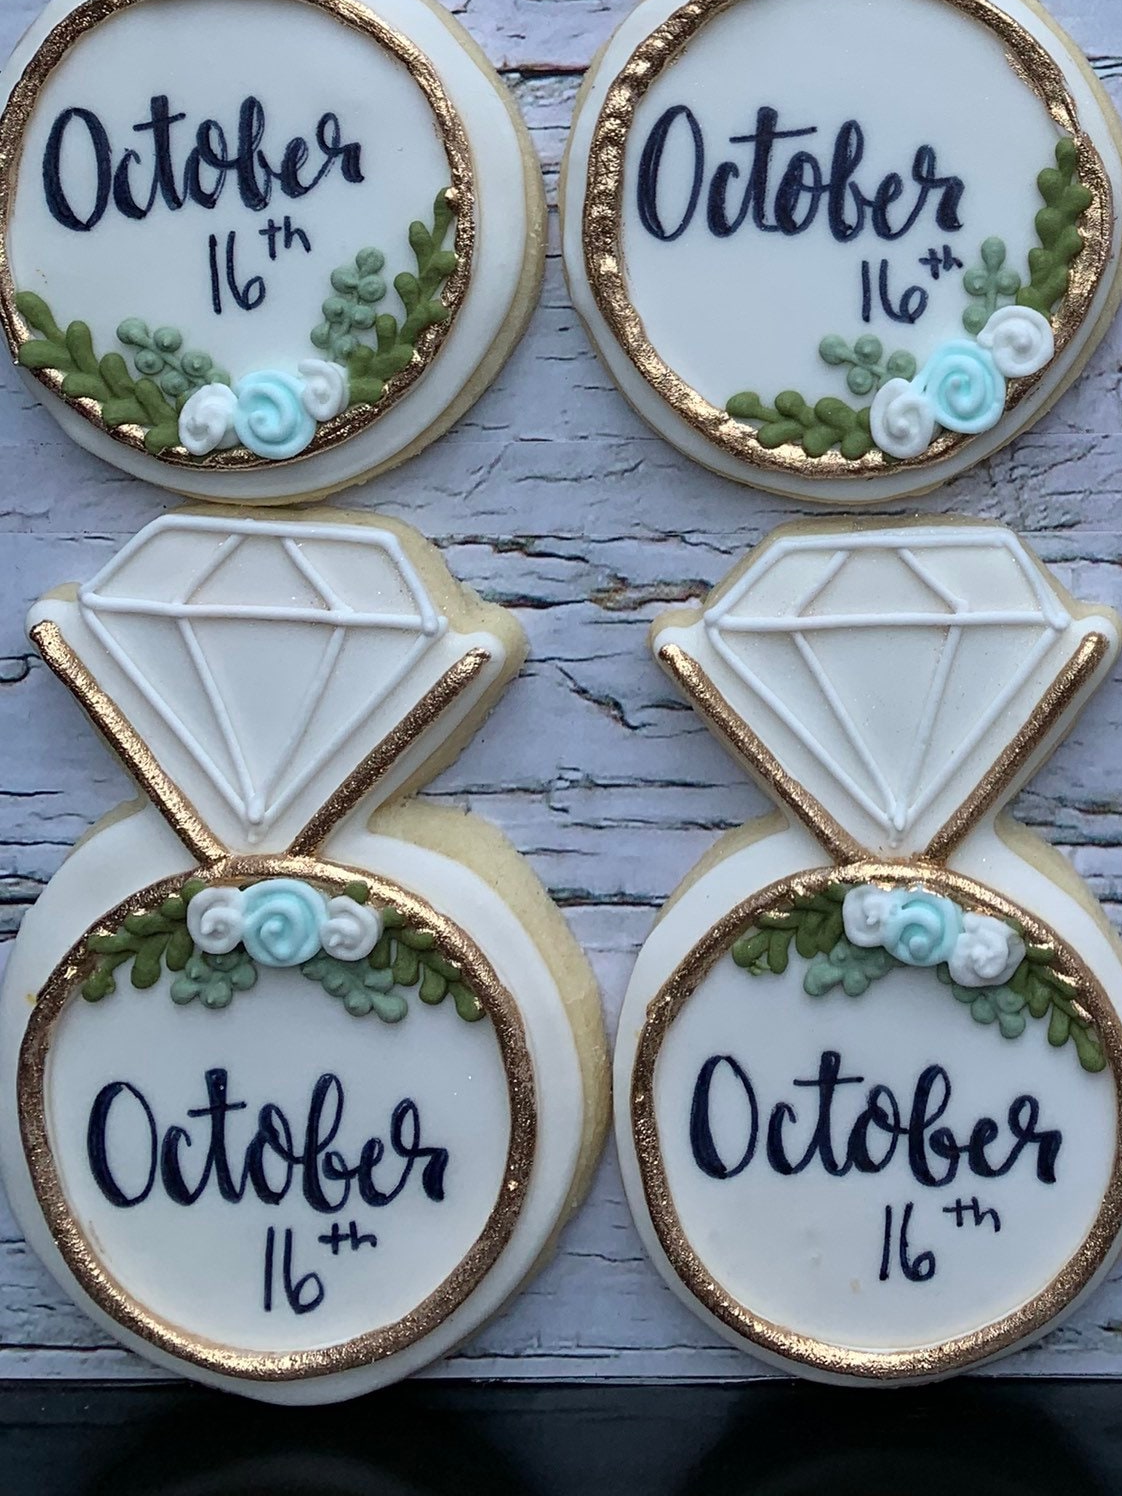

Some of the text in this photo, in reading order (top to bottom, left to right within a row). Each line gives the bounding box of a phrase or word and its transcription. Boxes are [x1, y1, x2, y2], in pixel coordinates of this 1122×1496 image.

[41, 94, 366, 233] October
[636, 104, 966, 244] October
[208, 215, 312, 316] 16th
[861, 244, 964, 325] 16th
[86, 1067, 450, 1215] October
[689, 1050, 1063, 1188] October
[263, 1220, 378, 1316] 16th
[878, 1196, 1002, 1283] 16th
